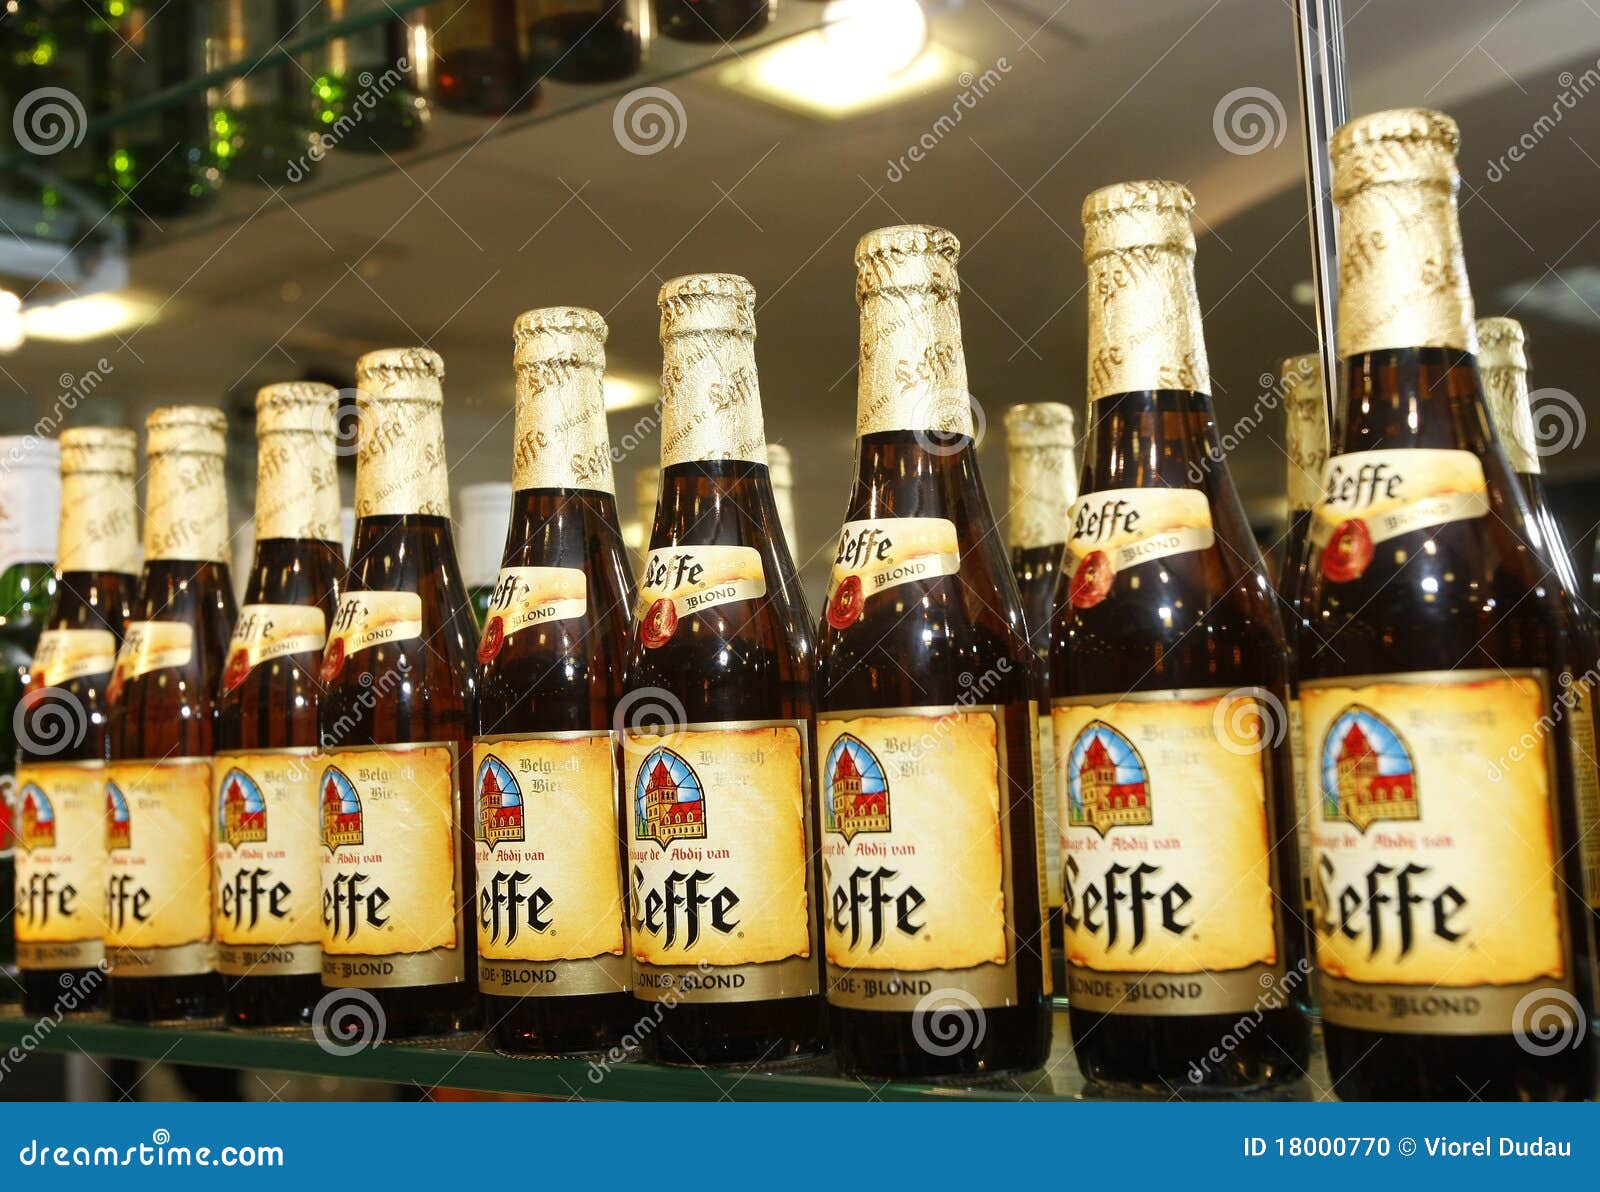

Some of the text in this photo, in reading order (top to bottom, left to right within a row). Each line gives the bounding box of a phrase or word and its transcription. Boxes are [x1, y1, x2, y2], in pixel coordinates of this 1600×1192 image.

[1324, 463, 1404, 509] Leffe
[1073, 500, 1141, 543] Leffe
[835, 528, 893, 569] Leffe
[642, 554, 704, 591] Leffe
[873, 563, 927, 588] BLOND
[685, 587, 736, 610] BLOND
[336, 852, 361, 865] Abdij
[364, 853, 383, 864] van
[496, 849, 521, 863] Abdij
[525, 851, 546, 862] van
[671, 847, 703, 863] Abdij
[706, 848, 731, 860] van
[856, 842, 887, 858] Abdij
[891, 844, 916, 856] van
[340, 961, 394, 978] BLOND
[500, 968, 557, 985] BLOND
[863, 979, 932, 998] BLOND
[1124, 982, 1203, 1002] BLOND
